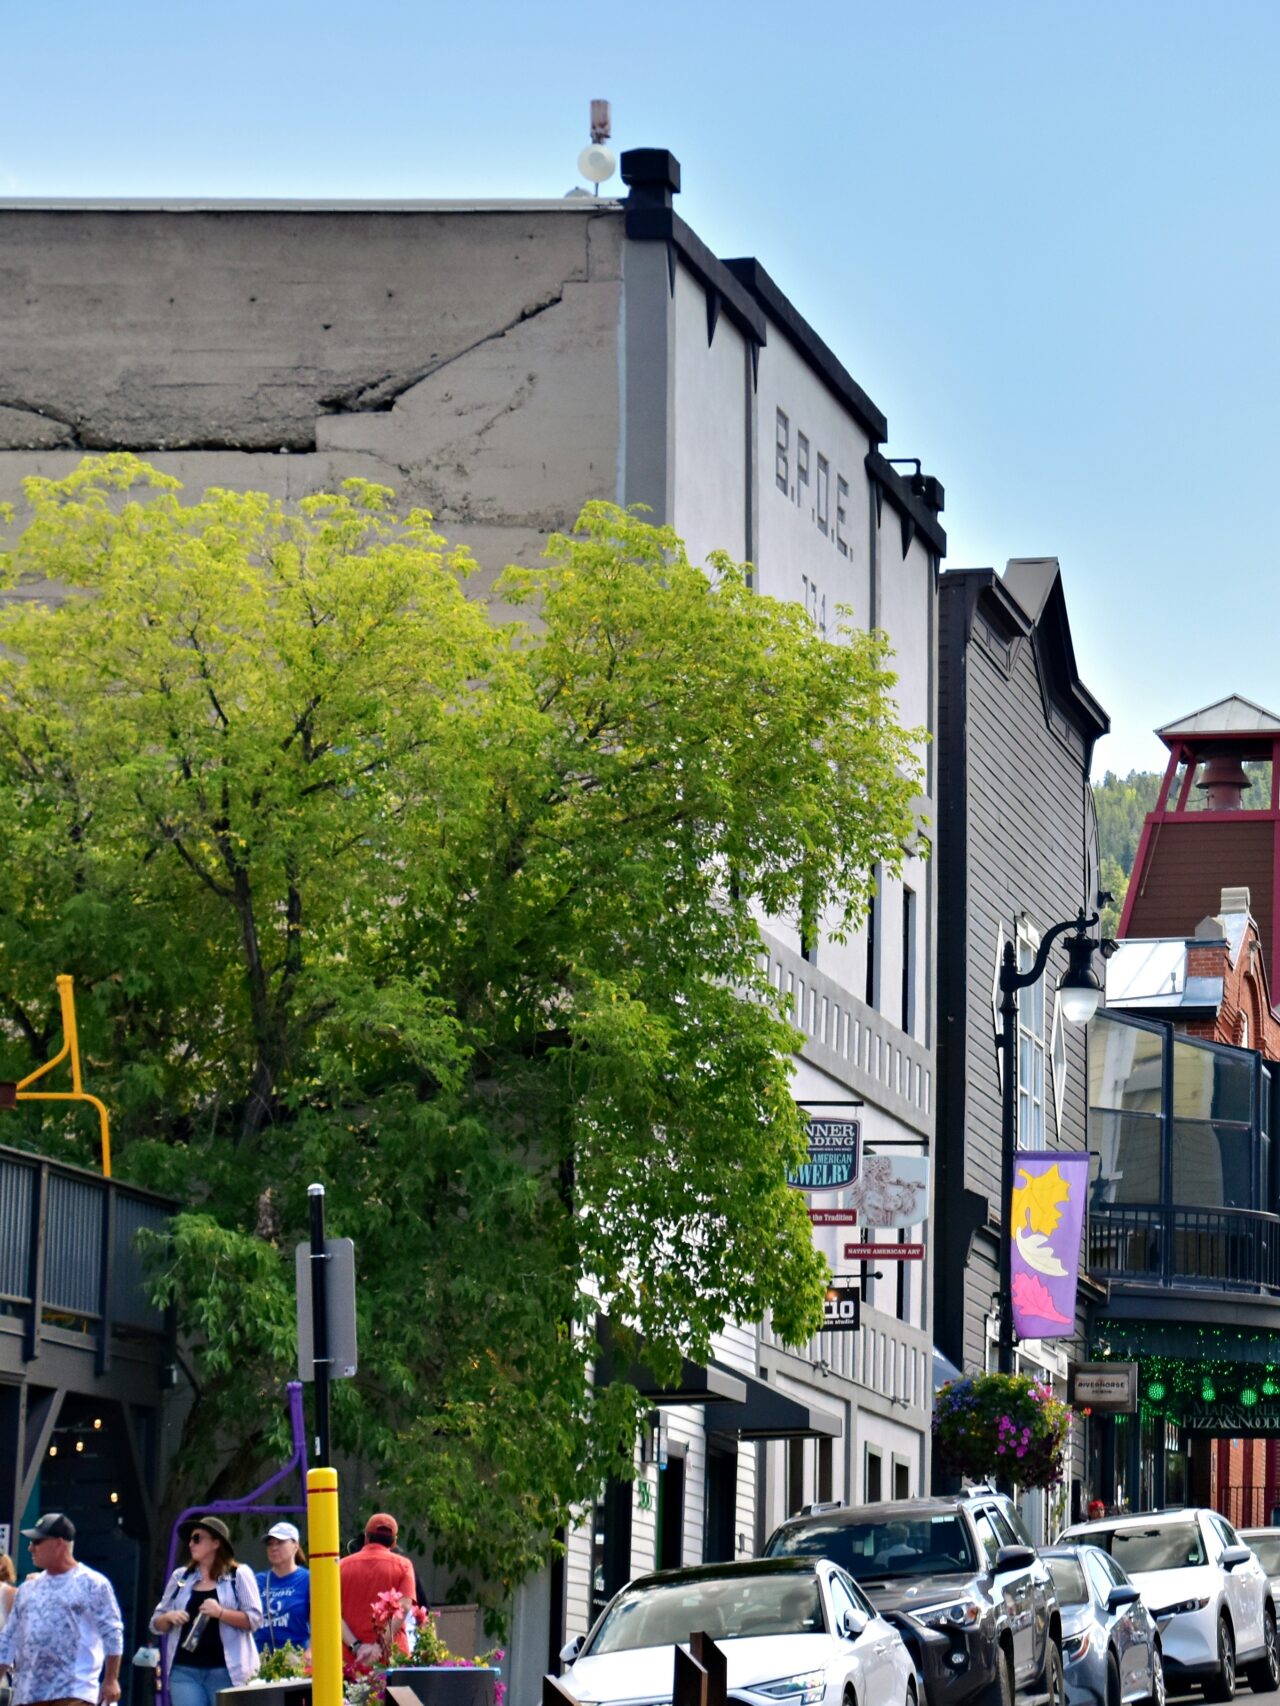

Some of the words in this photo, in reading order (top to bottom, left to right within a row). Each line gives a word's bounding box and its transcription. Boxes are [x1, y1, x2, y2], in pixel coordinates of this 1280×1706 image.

[803, 1123, 855, 1137] NNER
[812, 1153, 852, 1164] AMERICAN
[824, 1213, 853, 1221] Tradition
